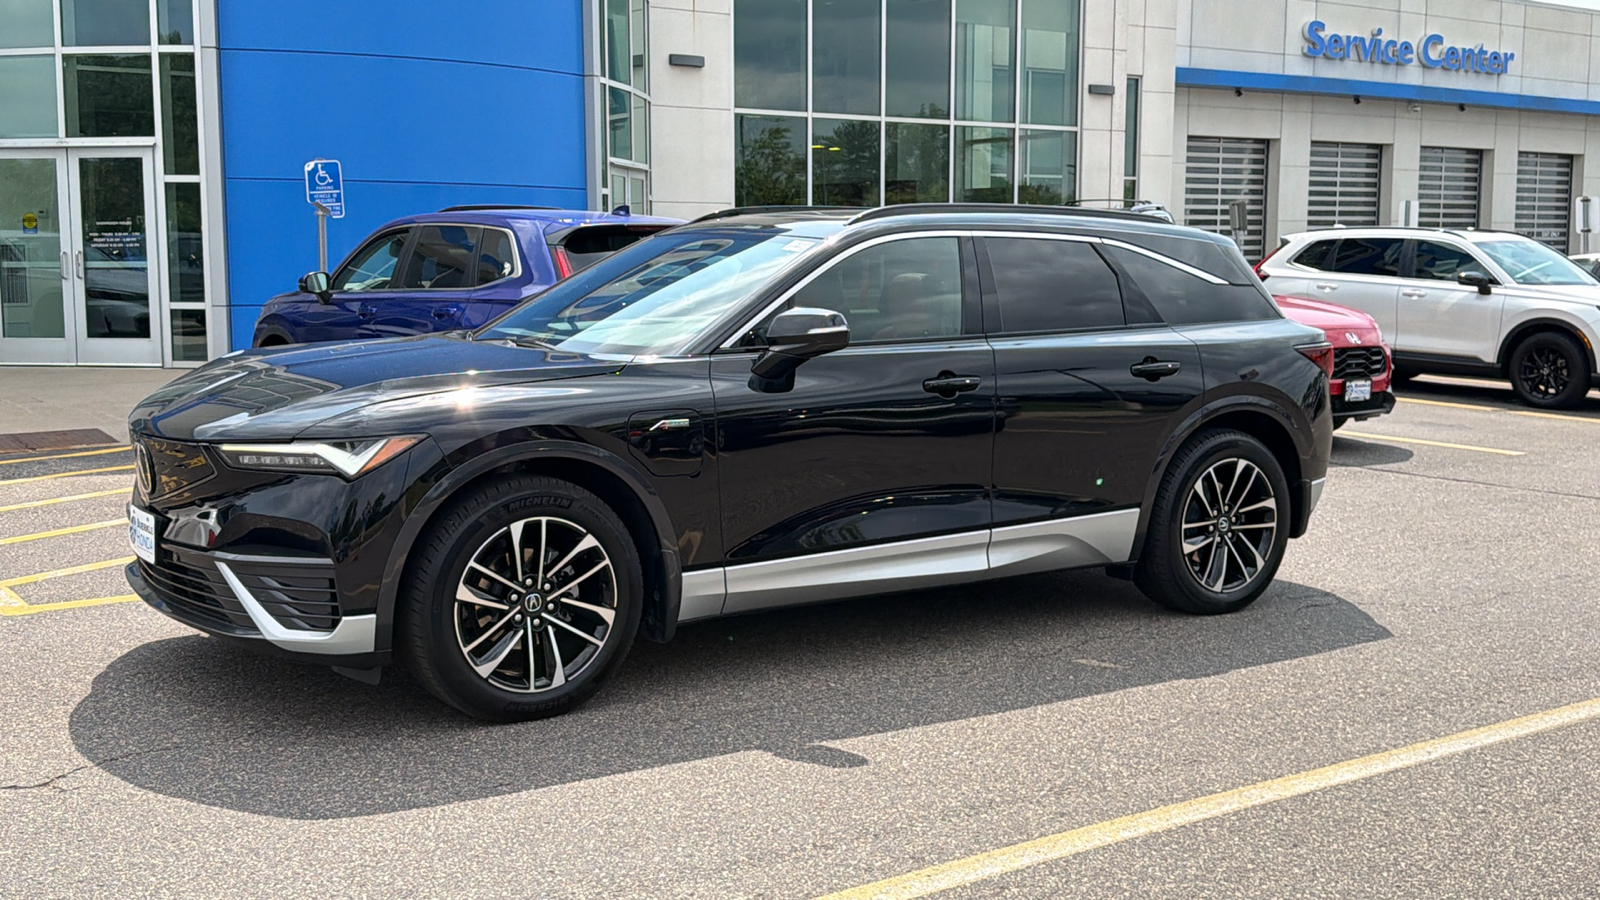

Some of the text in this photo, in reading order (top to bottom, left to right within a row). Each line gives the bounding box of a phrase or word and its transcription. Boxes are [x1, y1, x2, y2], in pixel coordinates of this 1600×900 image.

[1303, 20, 1515, 74] Service Center
[508, 496, 571, 512] MICHELIN
